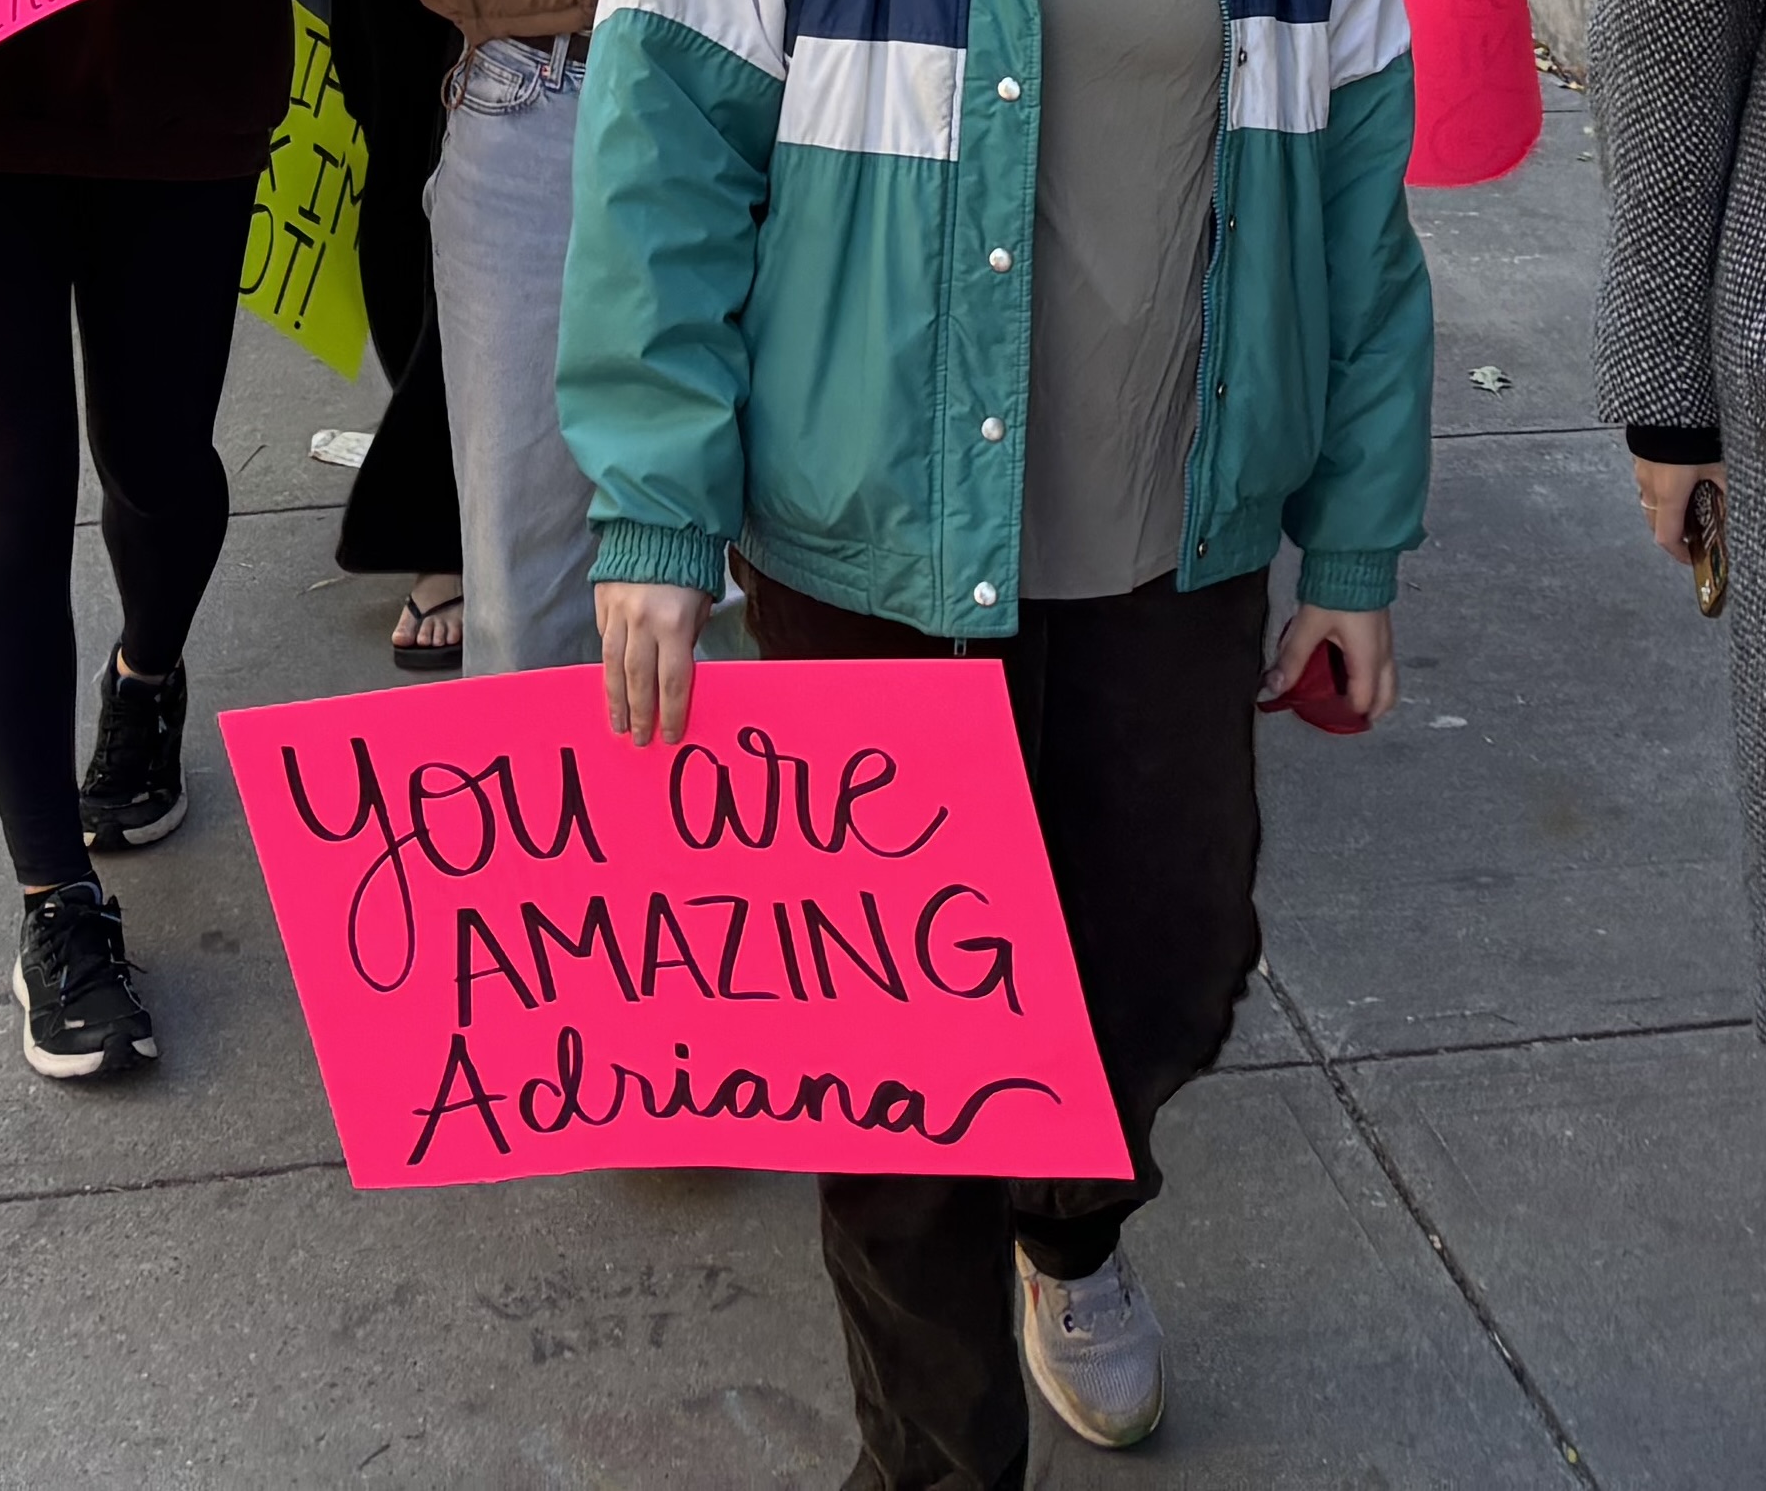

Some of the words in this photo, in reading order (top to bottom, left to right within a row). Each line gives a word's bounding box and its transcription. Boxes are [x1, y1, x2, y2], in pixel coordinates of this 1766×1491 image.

[670, 727, 948, 860] are
[454, 884, 1025, 1028] AMAZING
[406, 1026, 1063, 1166] Adriana
